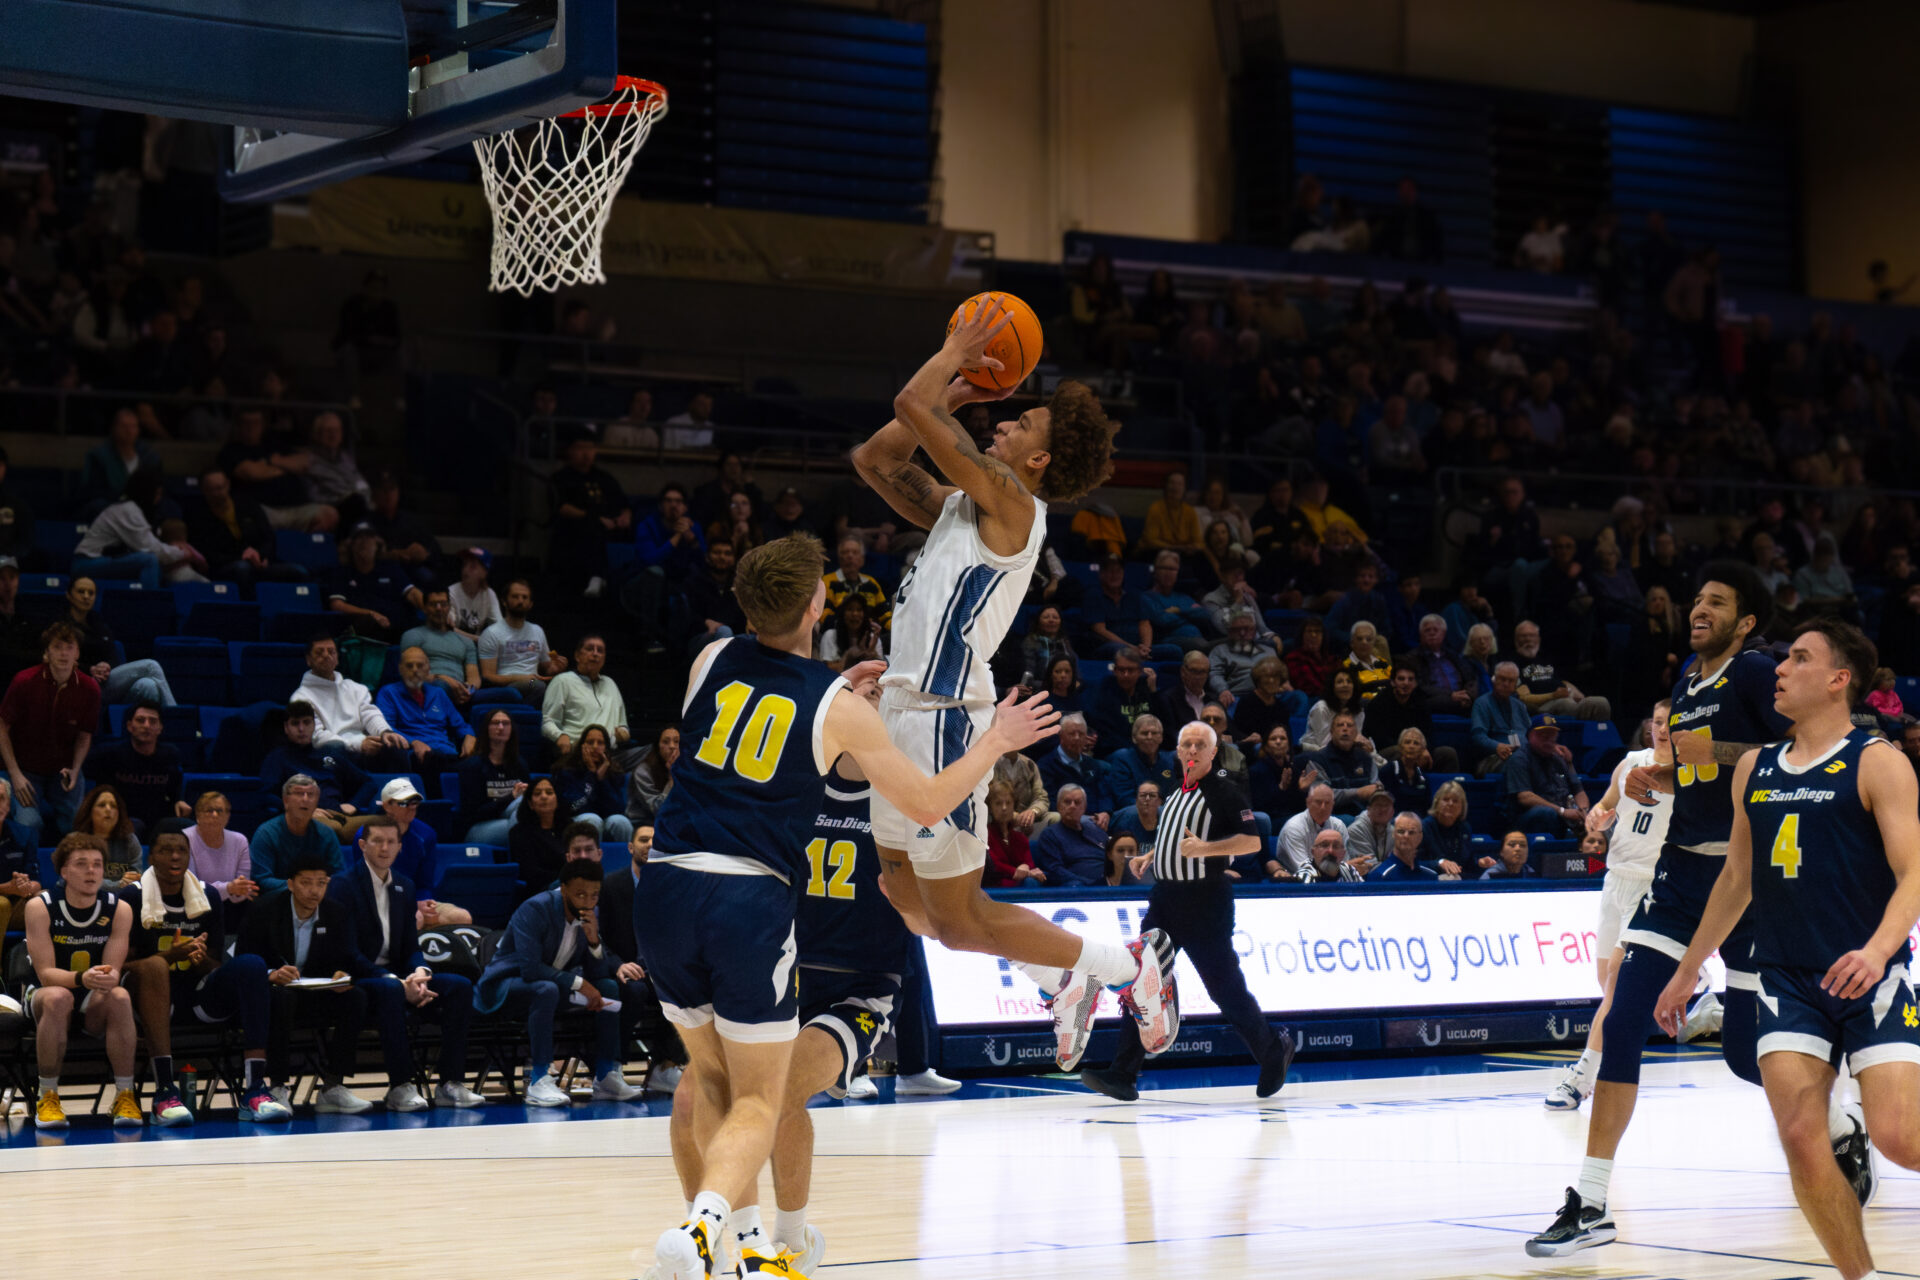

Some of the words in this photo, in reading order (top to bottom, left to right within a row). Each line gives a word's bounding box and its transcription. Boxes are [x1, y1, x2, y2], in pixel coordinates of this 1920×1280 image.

[695, 680, 797, 783] 10
[1632, 811, 1653, 834] 10
[1771, 813, 1803, 879] 4
[806, 837, 857, 900] 12
[1566, 859, 1587, 872] POSS.
[1441, 929, 1520, 981] your
[1309, 1032, 1353, 1047] ucu.org
[1446, 1026, 1489, 1041] ucu.org
[1017, 1046, 1057, 1058] ucu.or
